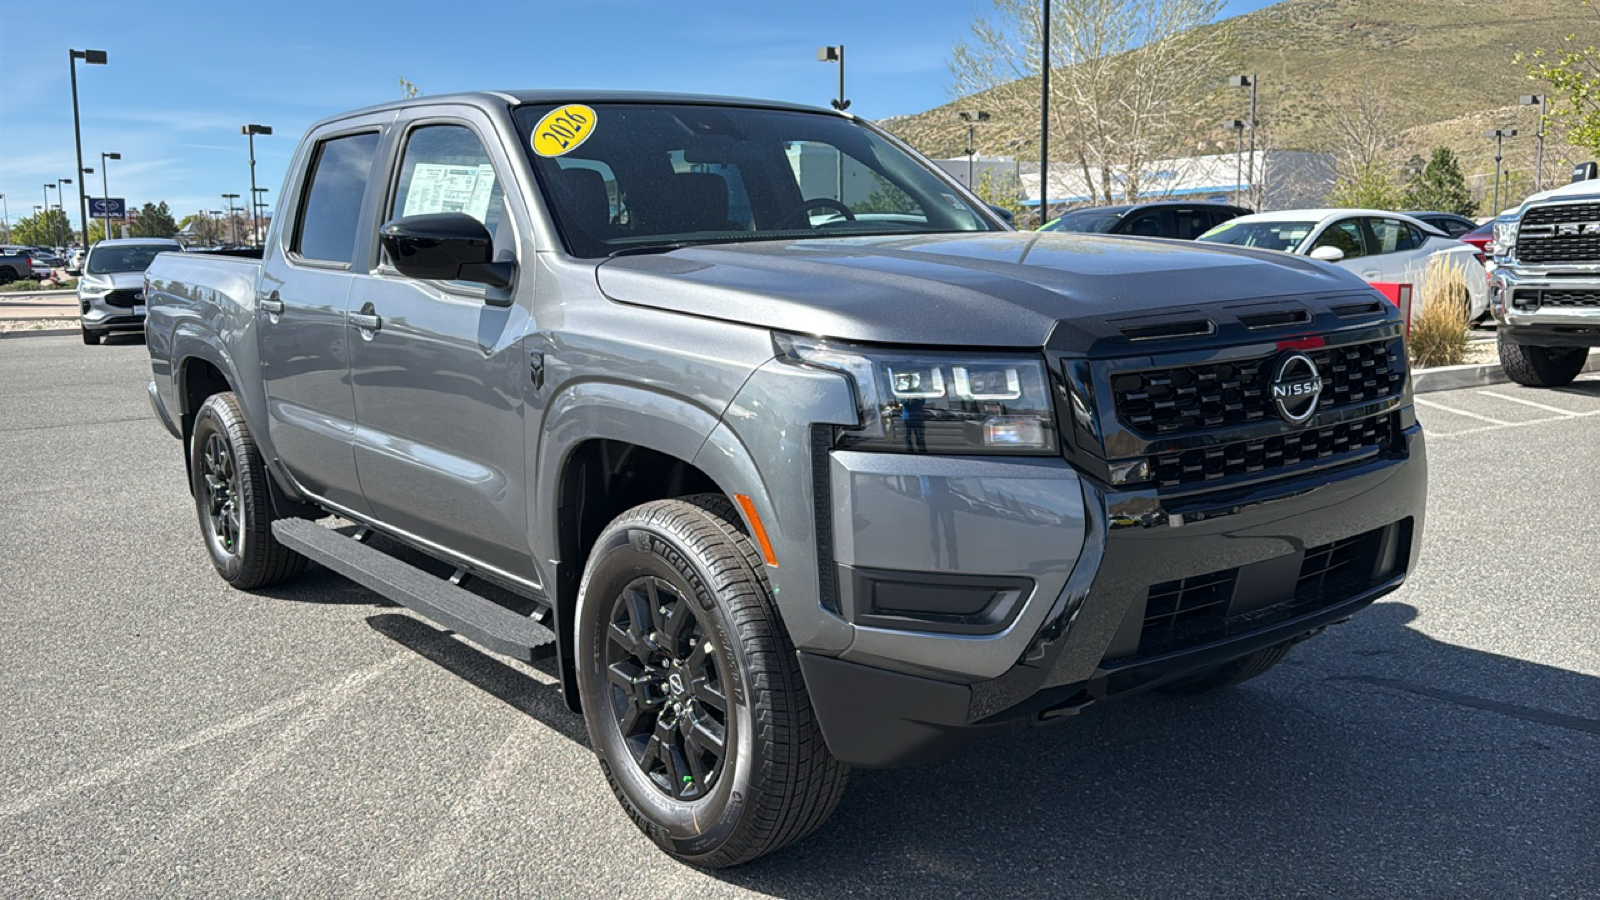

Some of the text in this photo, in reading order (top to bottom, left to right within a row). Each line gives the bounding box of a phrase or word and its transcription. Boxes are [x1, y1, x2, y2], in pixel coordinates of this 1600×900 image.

[542, 109, 587, 149] 2026
[1559, 223, 1600, 235] RA
[1274, 382, 1320, 396] NISSA
[653, 540, 712, 608] MICHELIN
